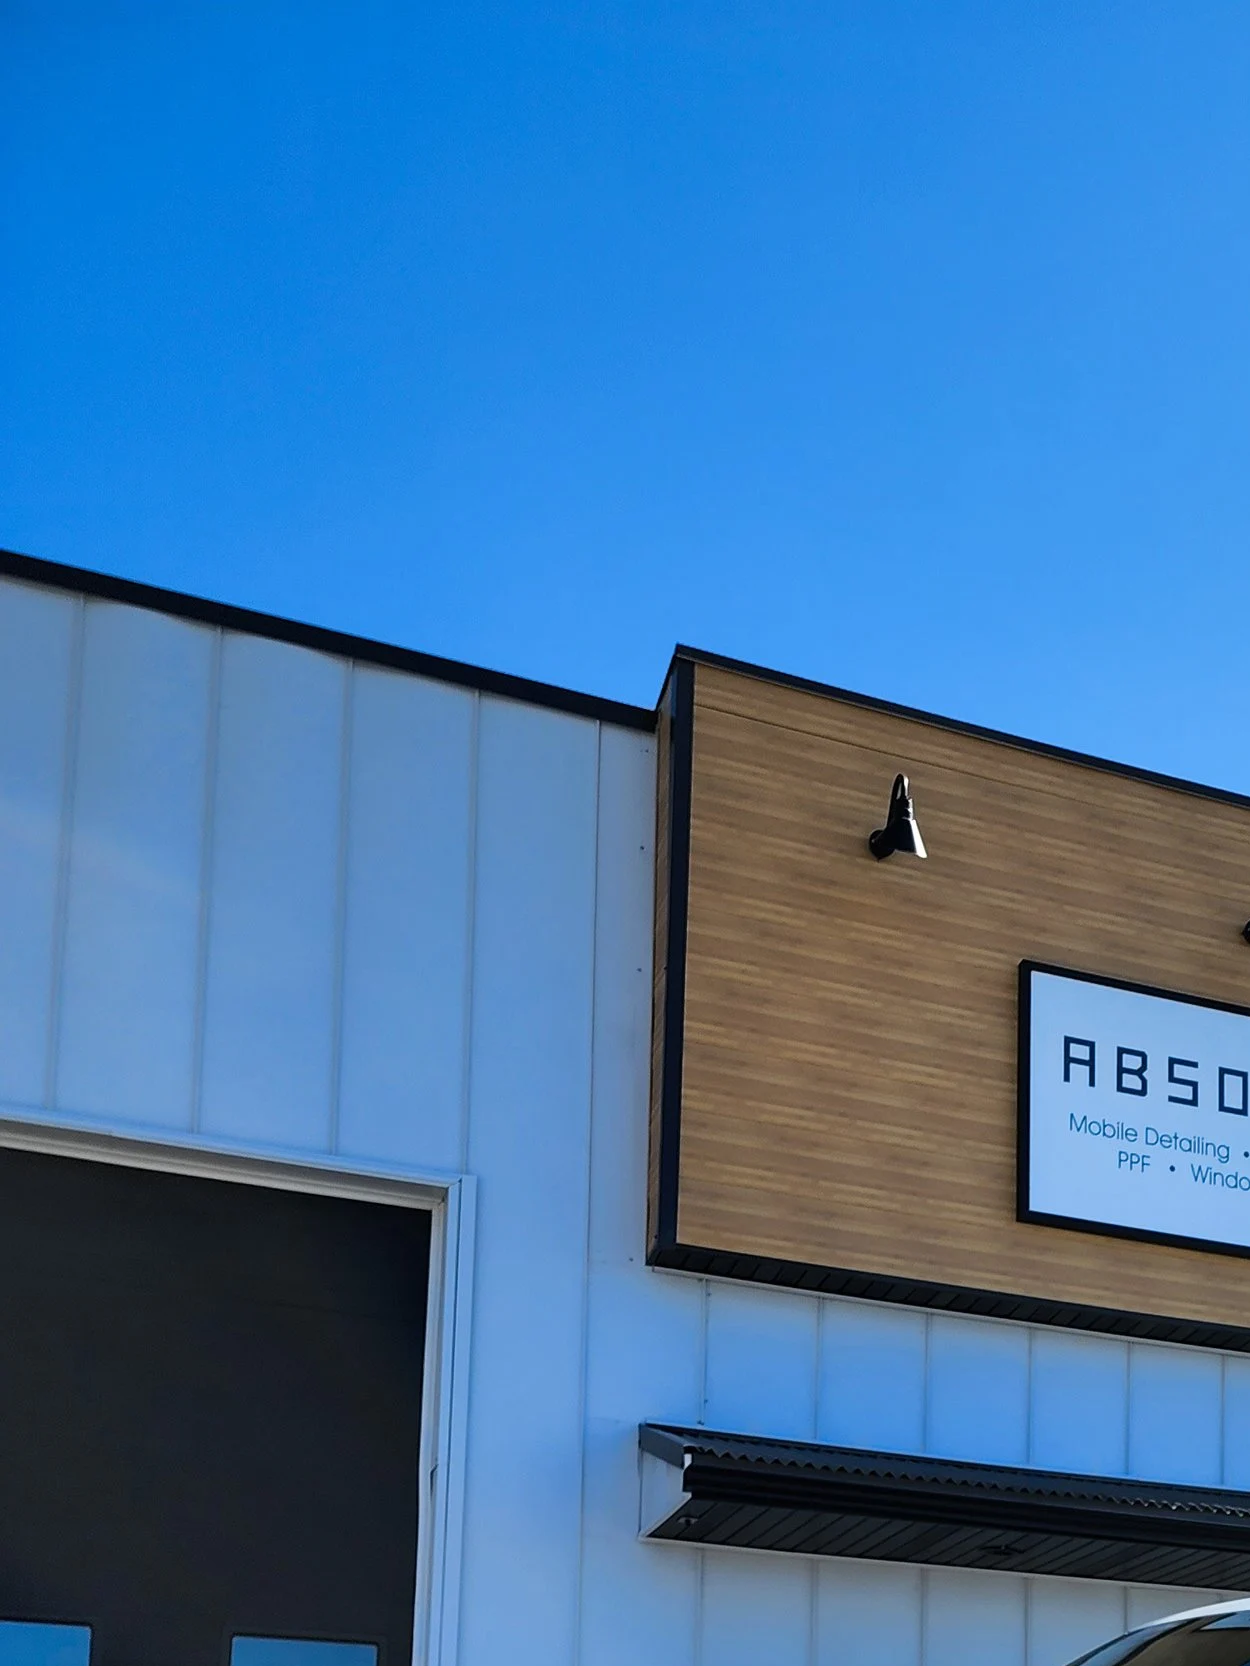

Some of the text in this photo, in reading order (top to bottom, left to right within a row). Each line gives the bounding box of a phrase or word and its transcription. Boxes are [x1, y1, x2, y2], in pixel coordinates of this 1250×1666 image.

[1069, 1113, 1138, 1143] Mobile
[1145, 1127, 1230, 1164] Detailing
[1118, 1151, 1151, 1173] PPF
